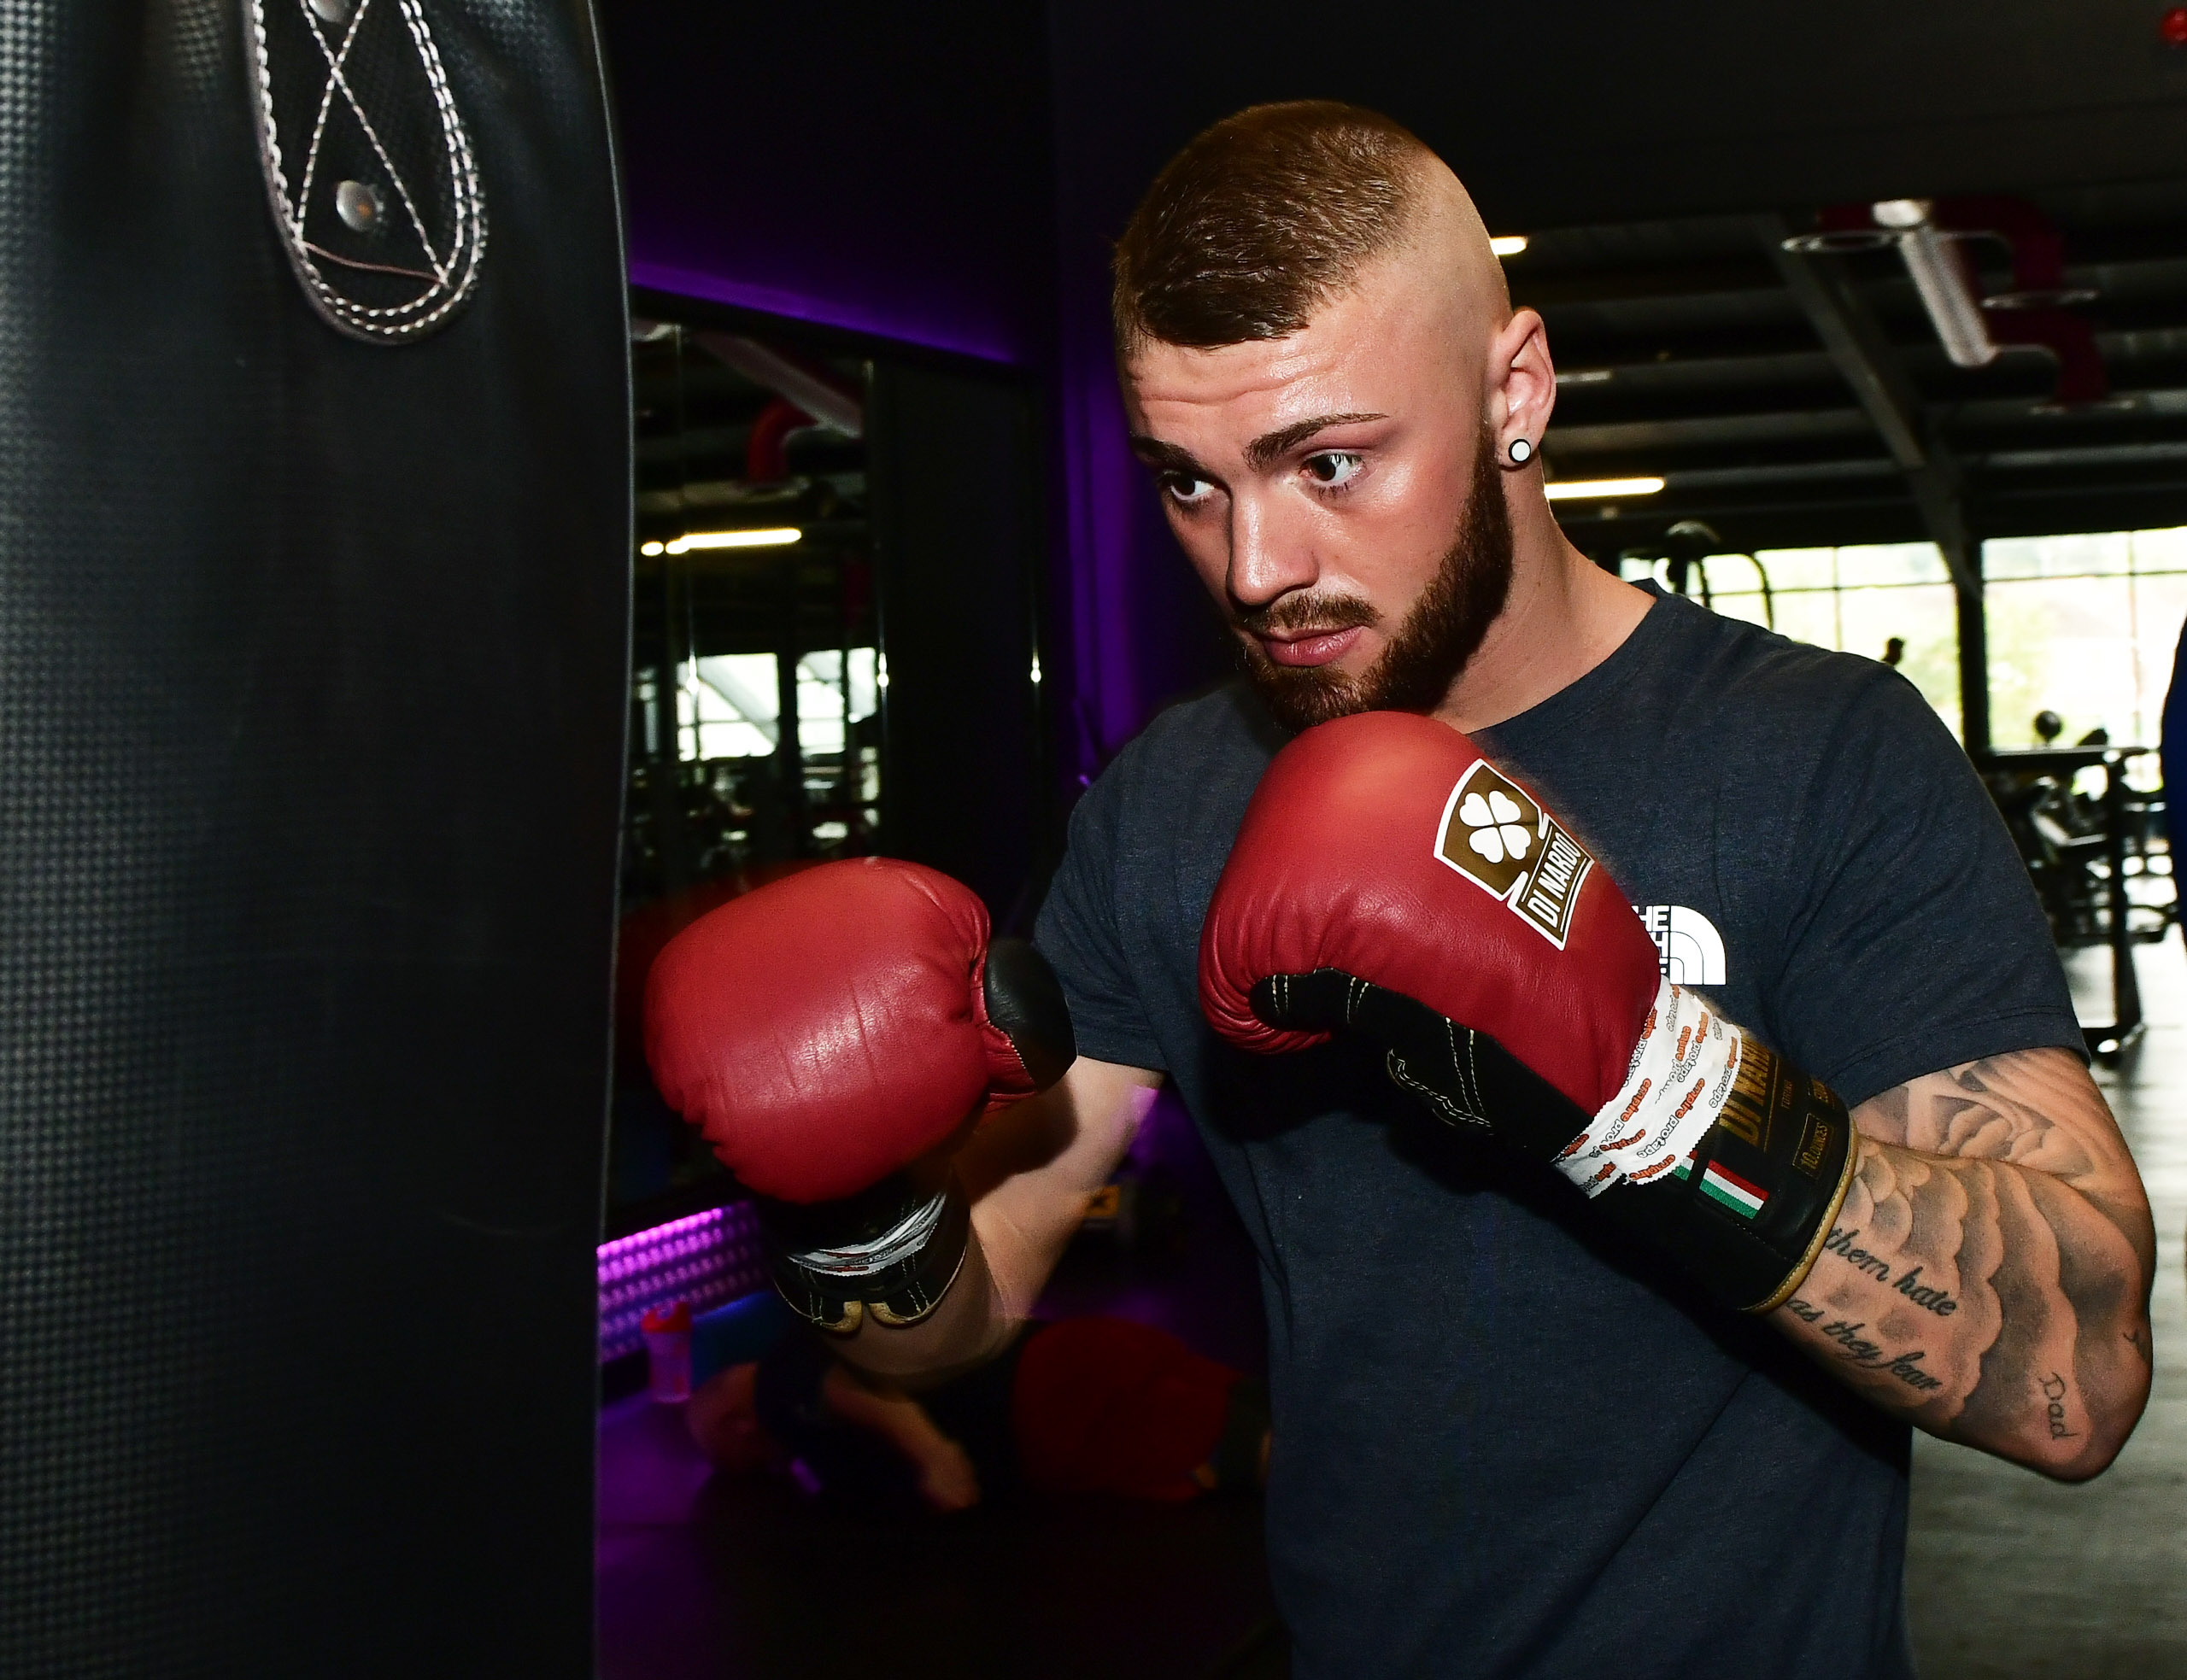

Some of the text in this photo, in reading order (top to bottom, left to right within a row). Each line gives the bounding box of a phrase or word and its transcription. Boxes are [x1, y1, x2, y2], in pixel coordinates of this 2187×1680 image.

[1527, 831, 1581, 928] DI NARDO
[1630, 905, 1669, 932] HE
[1674, 1026, 1692, 1062] empire
[1688, 1039, 1702, 1061] pro
[1676, 1057, 1697, 1083] tape
[1621, 1078, 1652, 1122] empire
[1674, 1077, 1706, 1119] empire
[1708, 1081, 1727, 1109] tape
[1598, 1128, 1646, 1152] empire
[1604, 1118, 1626, 1143] pro
[1660, 1114, 1680, 1139] pro
[1636, 1136, 1668, 1159] tape
[1628, 1154, 1676, 1181] empire
[1825, 1227, 1957, 1316] them hate
[1785, 1299, 1944, 1390] as they fear
[2037, 1372, 2079, 1440] Dad
